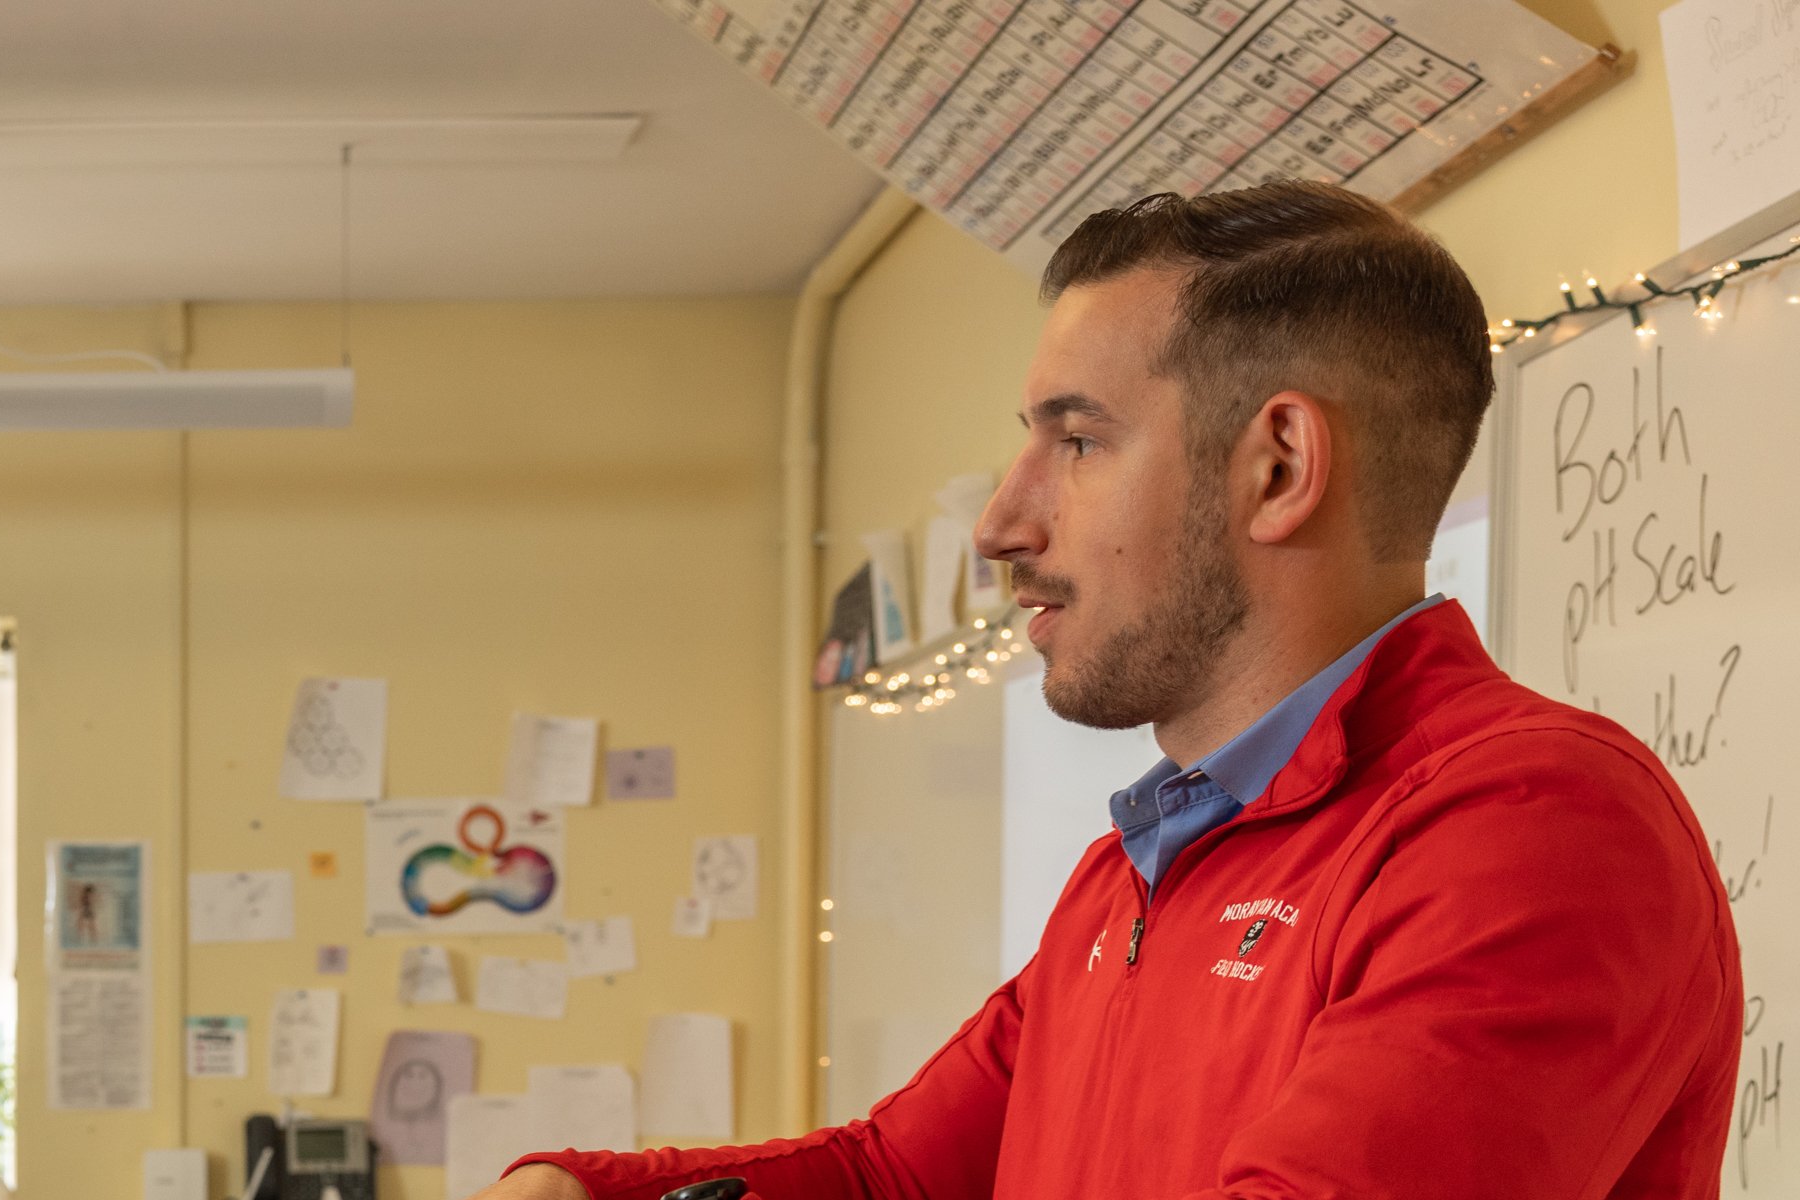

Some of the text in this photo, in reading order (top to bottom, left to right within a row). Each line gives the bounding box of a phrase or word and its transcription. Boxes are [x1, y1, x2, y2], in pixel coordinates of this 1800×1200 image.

[1553, 345, 1692, 542] Both
[1562, 473, 1737, 695] pH Scale
[1739, 1041, 1784, 1190] pH
